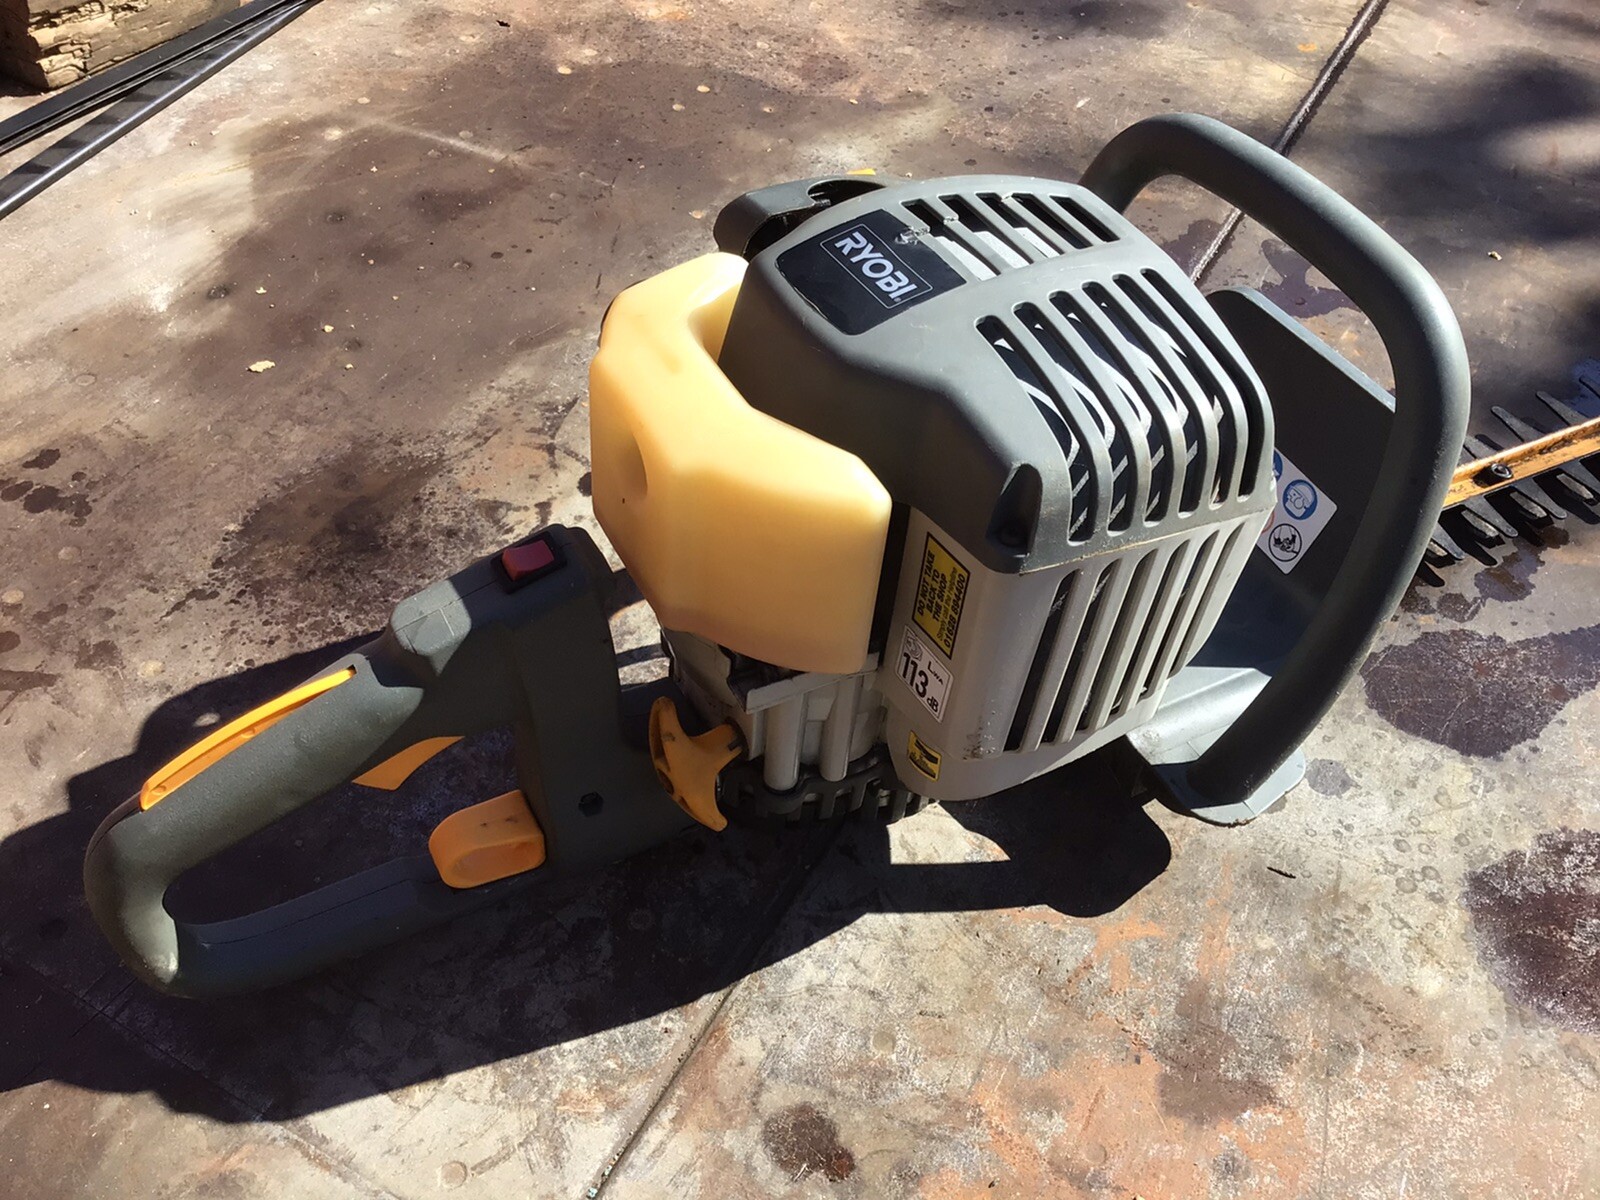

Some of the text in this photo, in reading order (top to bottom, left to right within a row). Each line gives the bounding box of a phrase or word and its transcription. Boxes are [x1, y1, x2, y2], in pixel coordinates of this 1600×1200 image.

[834, 231, 918, 299] RYOBI
[917, 550, 935, 616] DO NOT TAKE
[926, 569, 940, 614] BACK TO
[932, 573, 948, 622] THE SHOP
[902, 652, 939, 713] 113 dB
